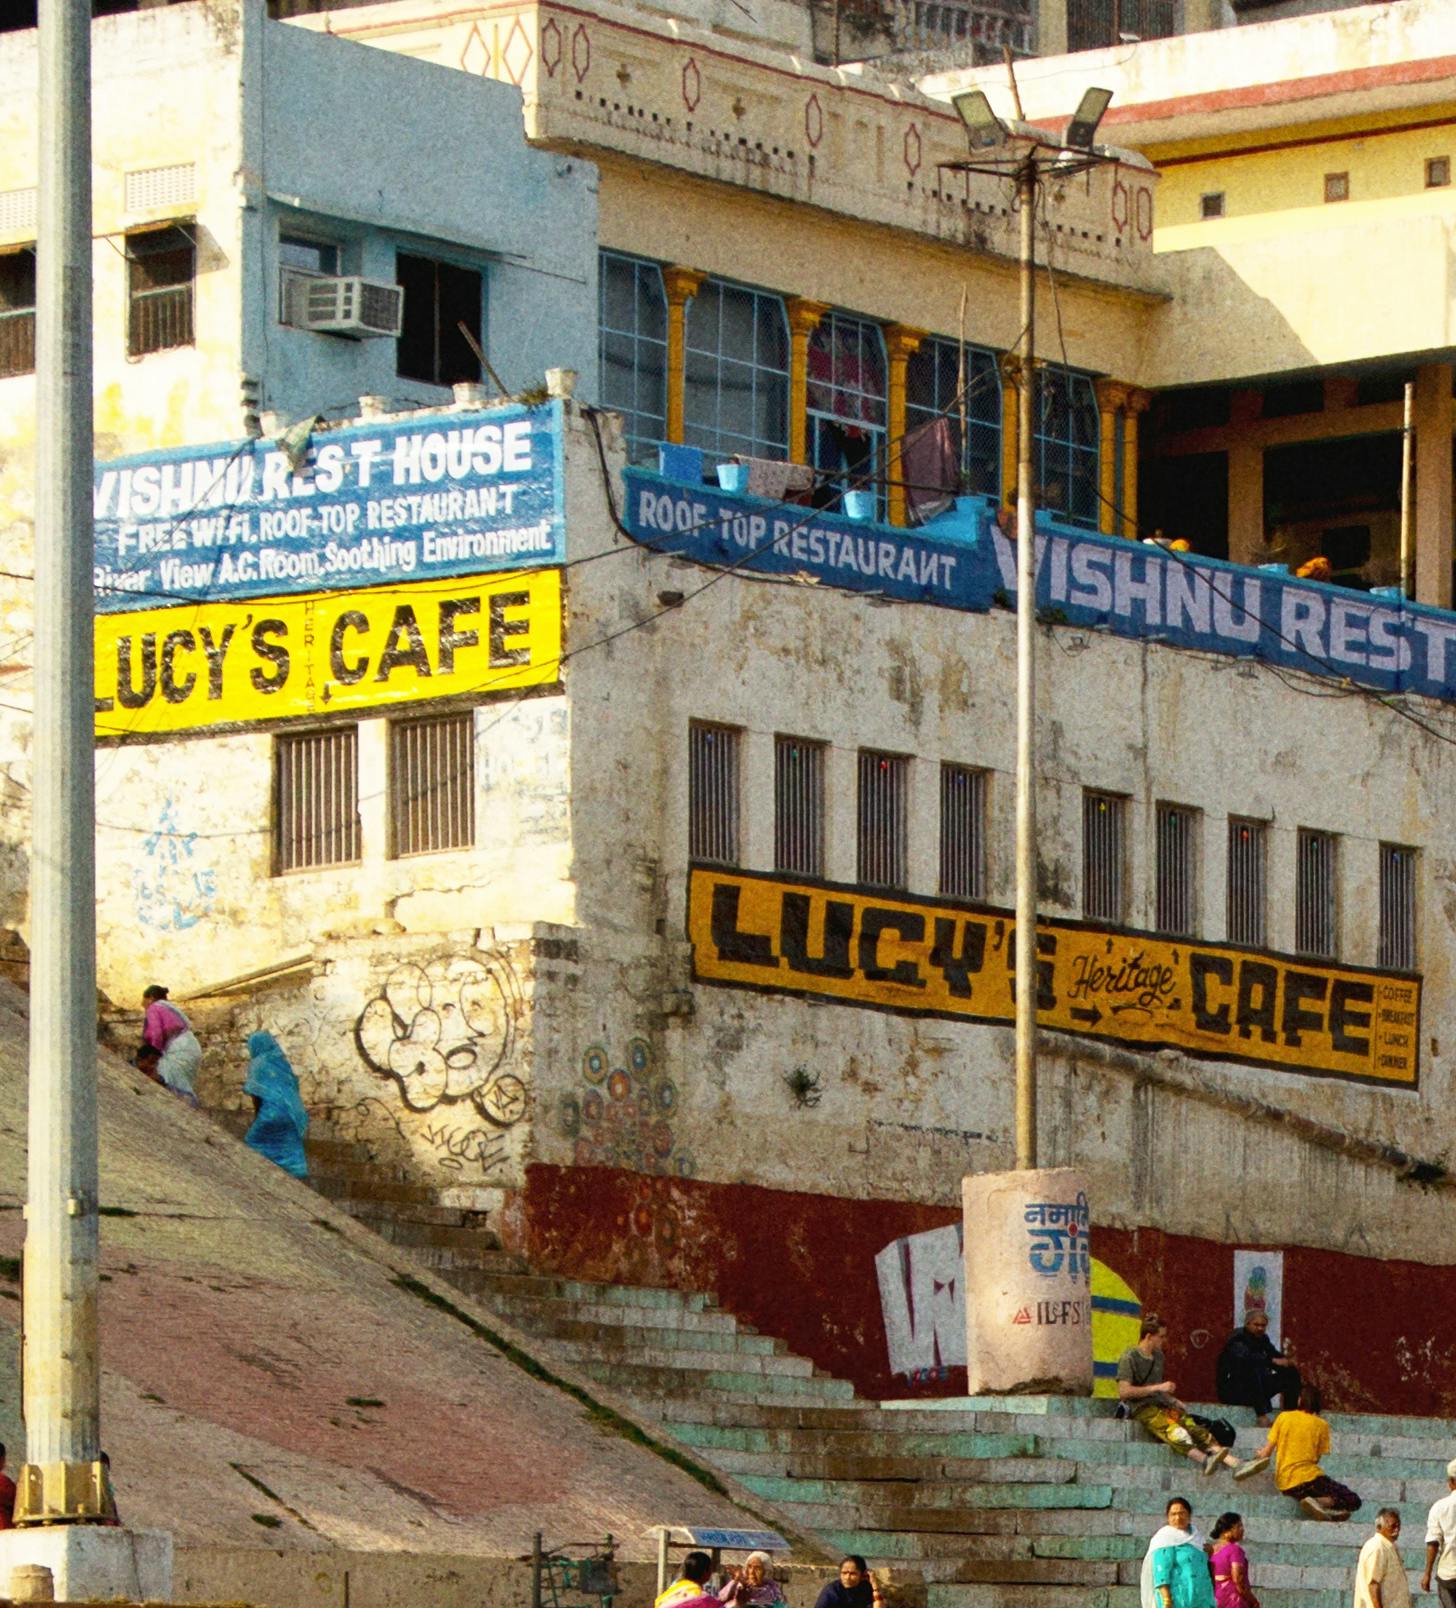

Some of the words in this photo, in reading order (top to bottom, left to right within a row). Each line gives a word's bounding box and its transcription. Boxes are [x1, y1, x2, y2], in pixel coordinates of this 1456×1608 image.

[93, 453, 255, 520] VISHNU
[393, 420, 532, 486] HOUSE
[117, 520, 188, 557] FREE
[160, 556, 216, 591] View
[422, 518, 553, 563] Environment
[990, 523, 1261, 643] VISHNU
[94, 613, 290, 713] UCY'S
[330, 590, 532, 687] CAFE
[710, 882, 1058, 1012] LUCY'S
[1067, 950, 1179, 1008] Heritage
[1189, 951, 1376, 1057] CAFE
